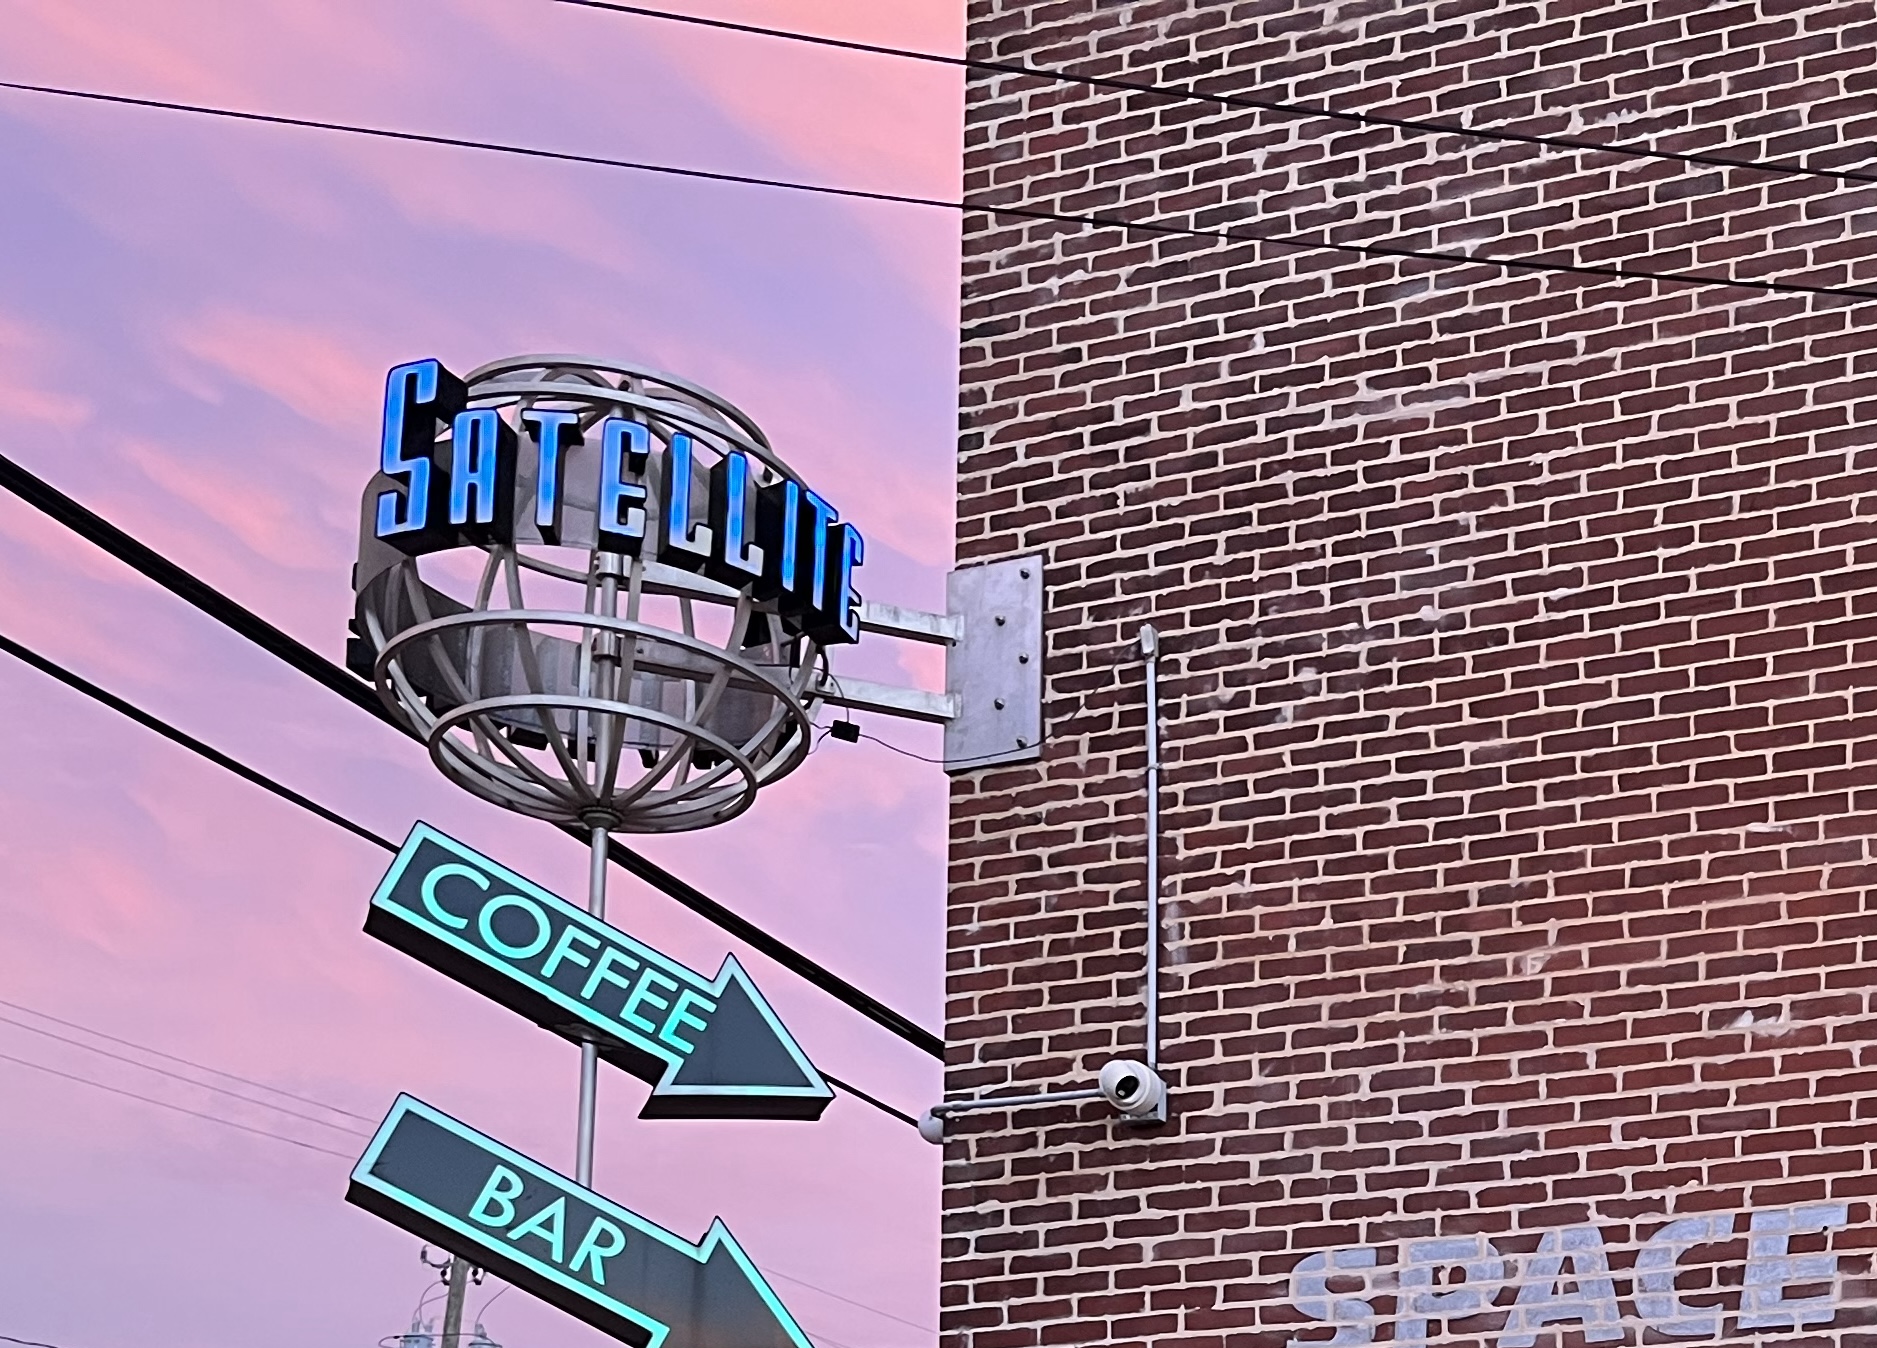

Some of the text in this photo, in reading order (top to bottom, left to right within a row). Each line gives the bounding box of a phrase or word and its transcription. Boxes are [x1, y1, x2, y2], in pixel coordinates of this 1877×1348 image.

[375, 357, 865, 645] SATELLITE
[420, 862, 717, 1054] COFFEE
[468, 1164, 627, 1292] BAR
